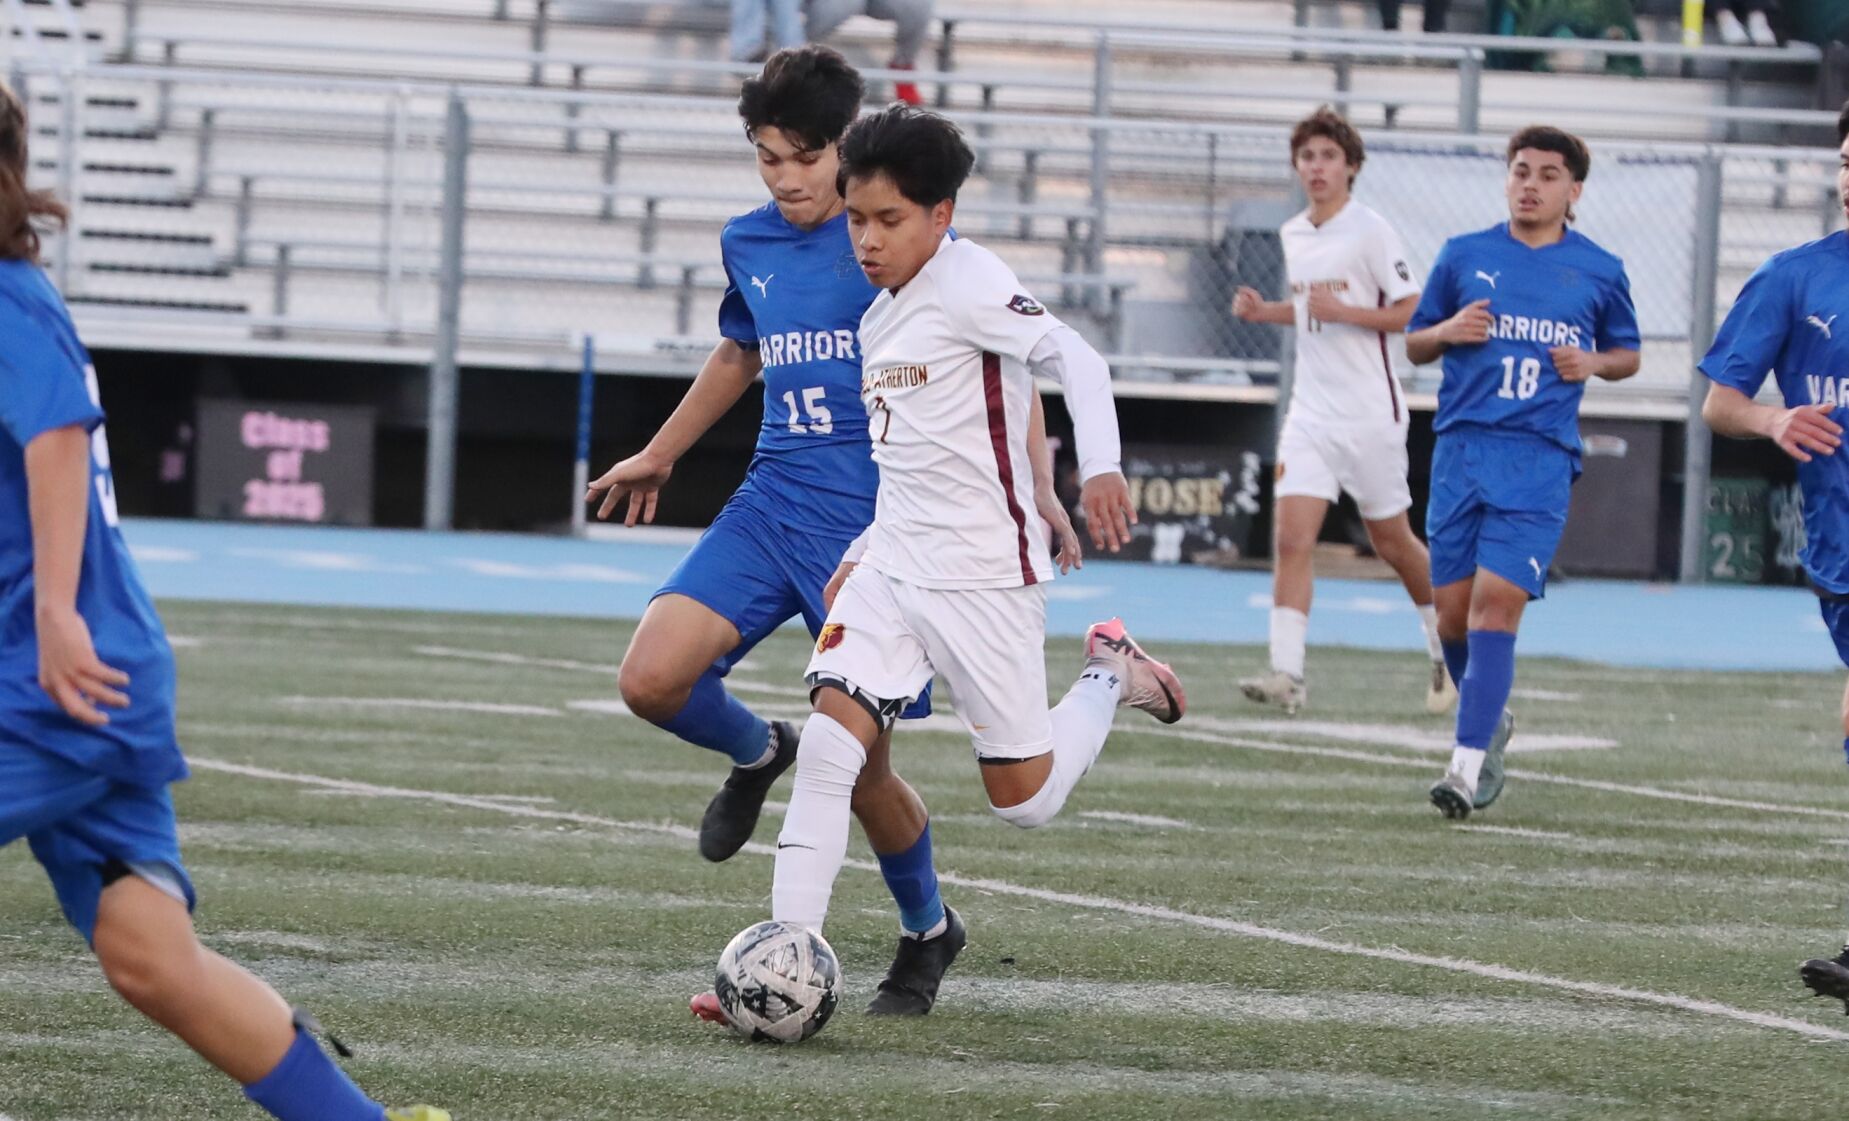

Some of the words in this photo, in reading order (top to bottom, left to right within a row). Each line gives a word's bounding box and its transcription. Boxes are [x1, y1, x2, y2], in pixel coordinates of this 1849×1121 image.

[759, 329, 856, 368] ARRIOR
[1487, 313, 1581, 349] ARRIORS
[1497, 355, 1541, 400] 18
[782, 386, 833, 435] 15
[266, 449, 303, 481] of
